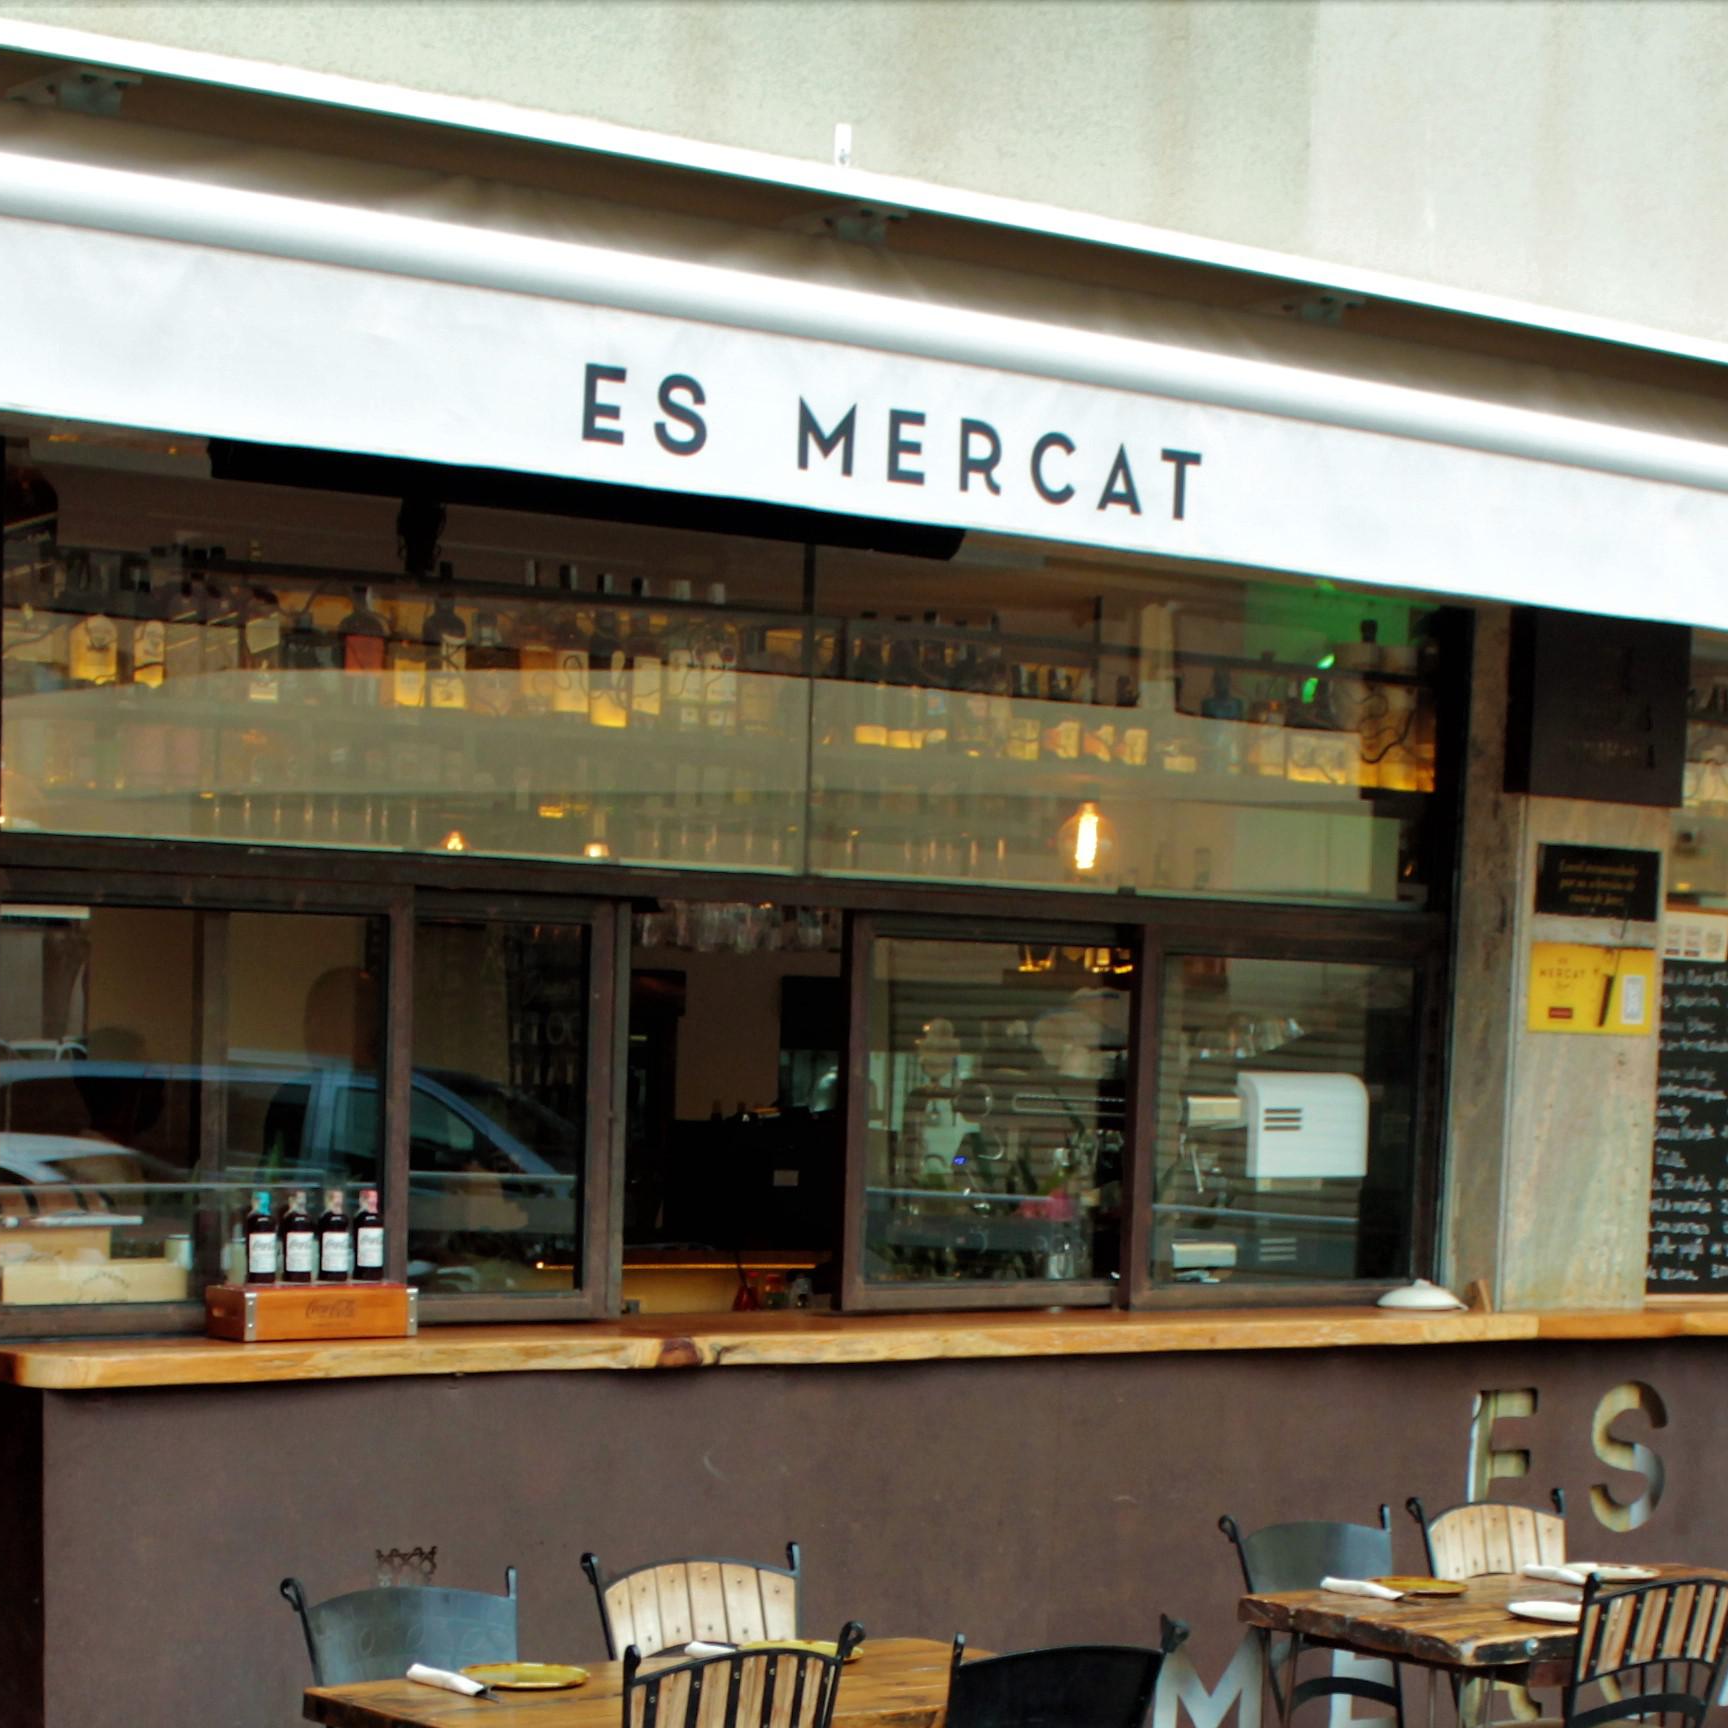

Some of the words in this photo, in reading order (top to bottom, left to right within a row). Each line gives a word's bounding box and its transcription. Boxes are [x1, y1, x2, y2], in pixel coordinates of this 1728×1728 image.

[582, 362, 708, 457] ES
[797, 394, 1203, 522] MERCAT
[1466, 1380, 1668, 1533] ES
